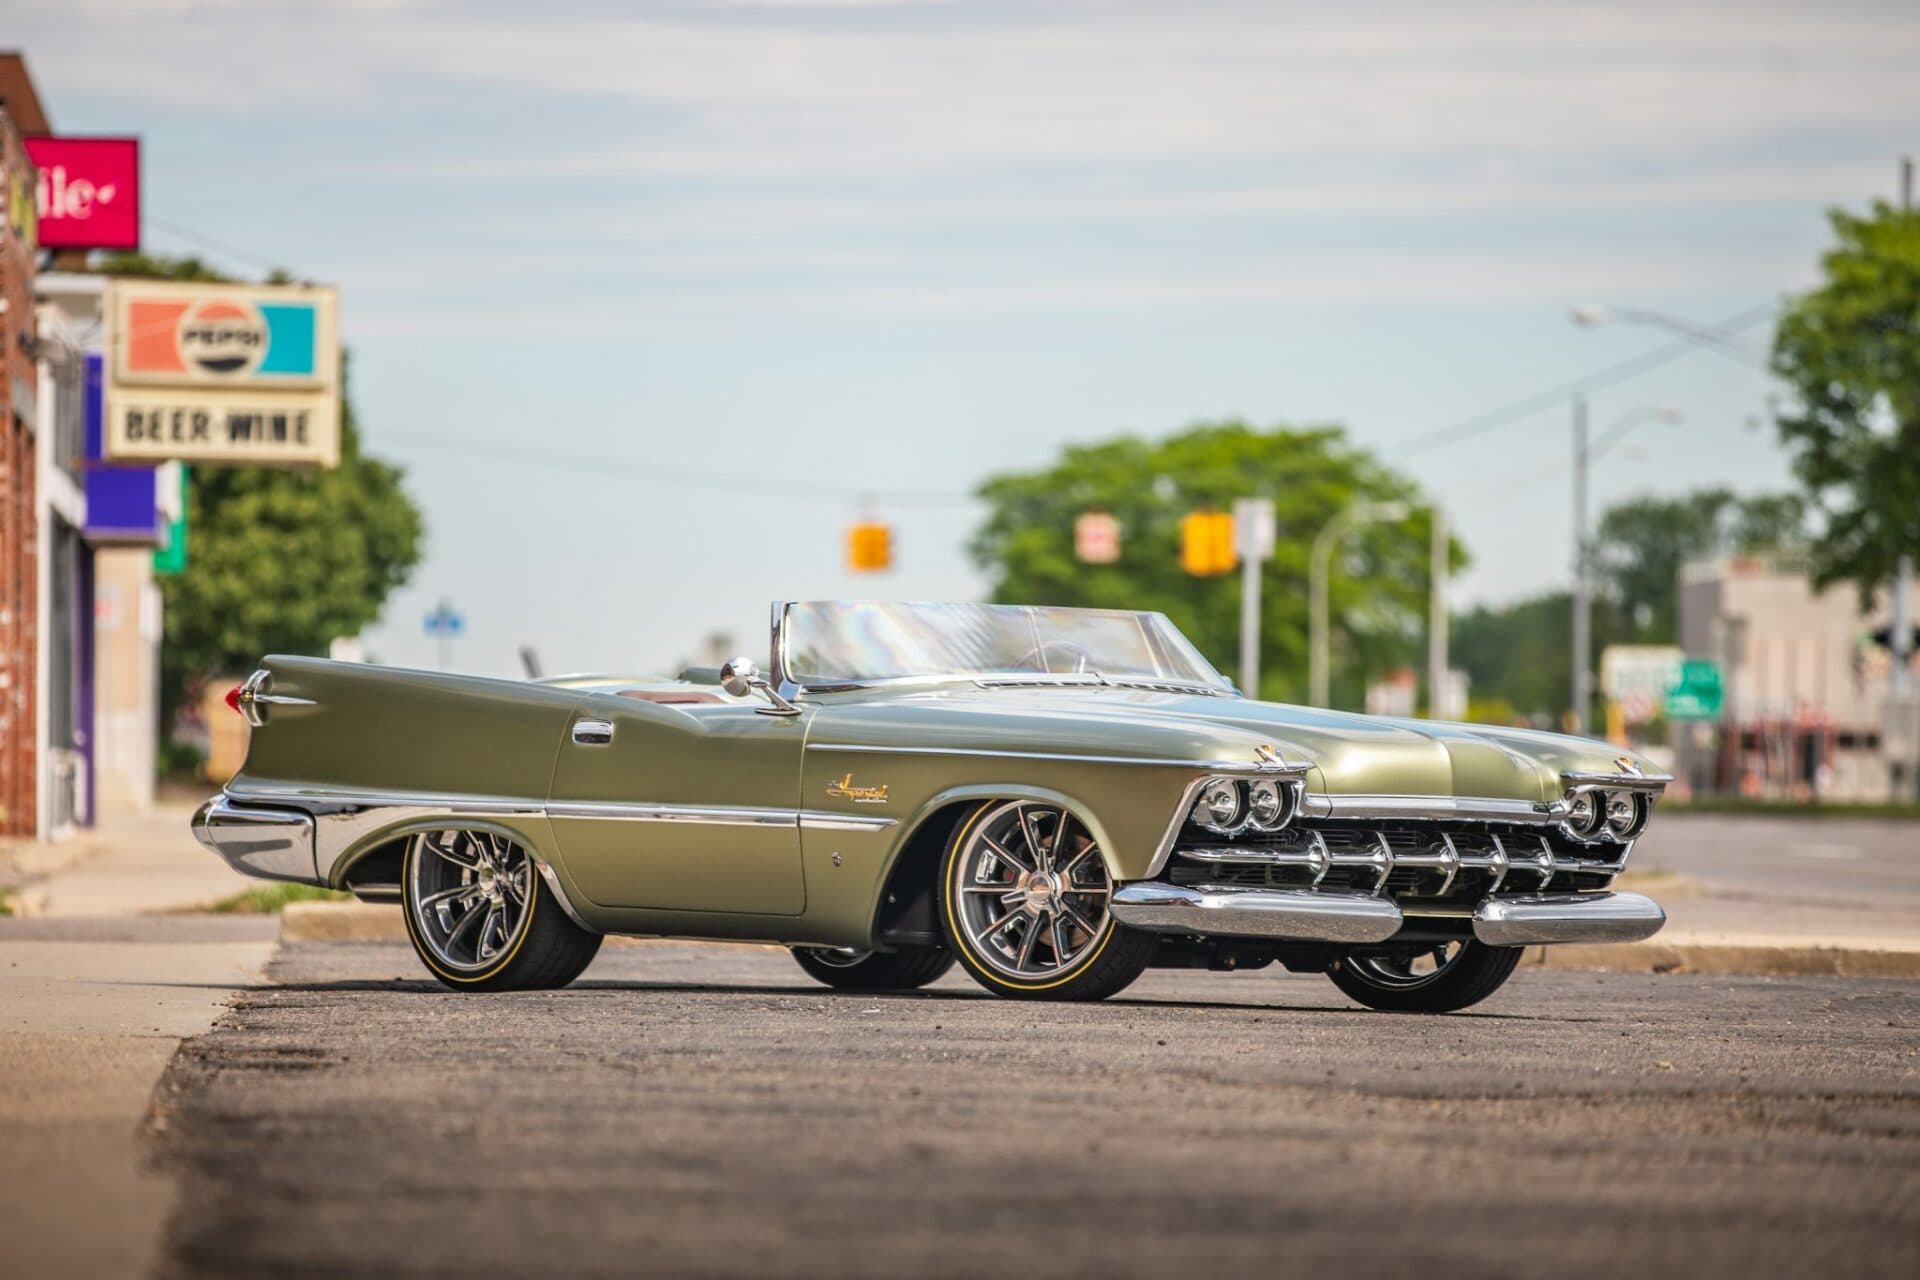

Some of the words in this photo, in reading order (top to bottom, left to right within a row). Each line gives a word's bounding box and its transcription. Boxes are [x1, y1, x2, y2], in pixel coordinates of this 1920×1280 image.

[182, 327, 261, 349] PEPSI
[126, 409, 210, 442] BEER
[227, 412, 310, 446] WINE
